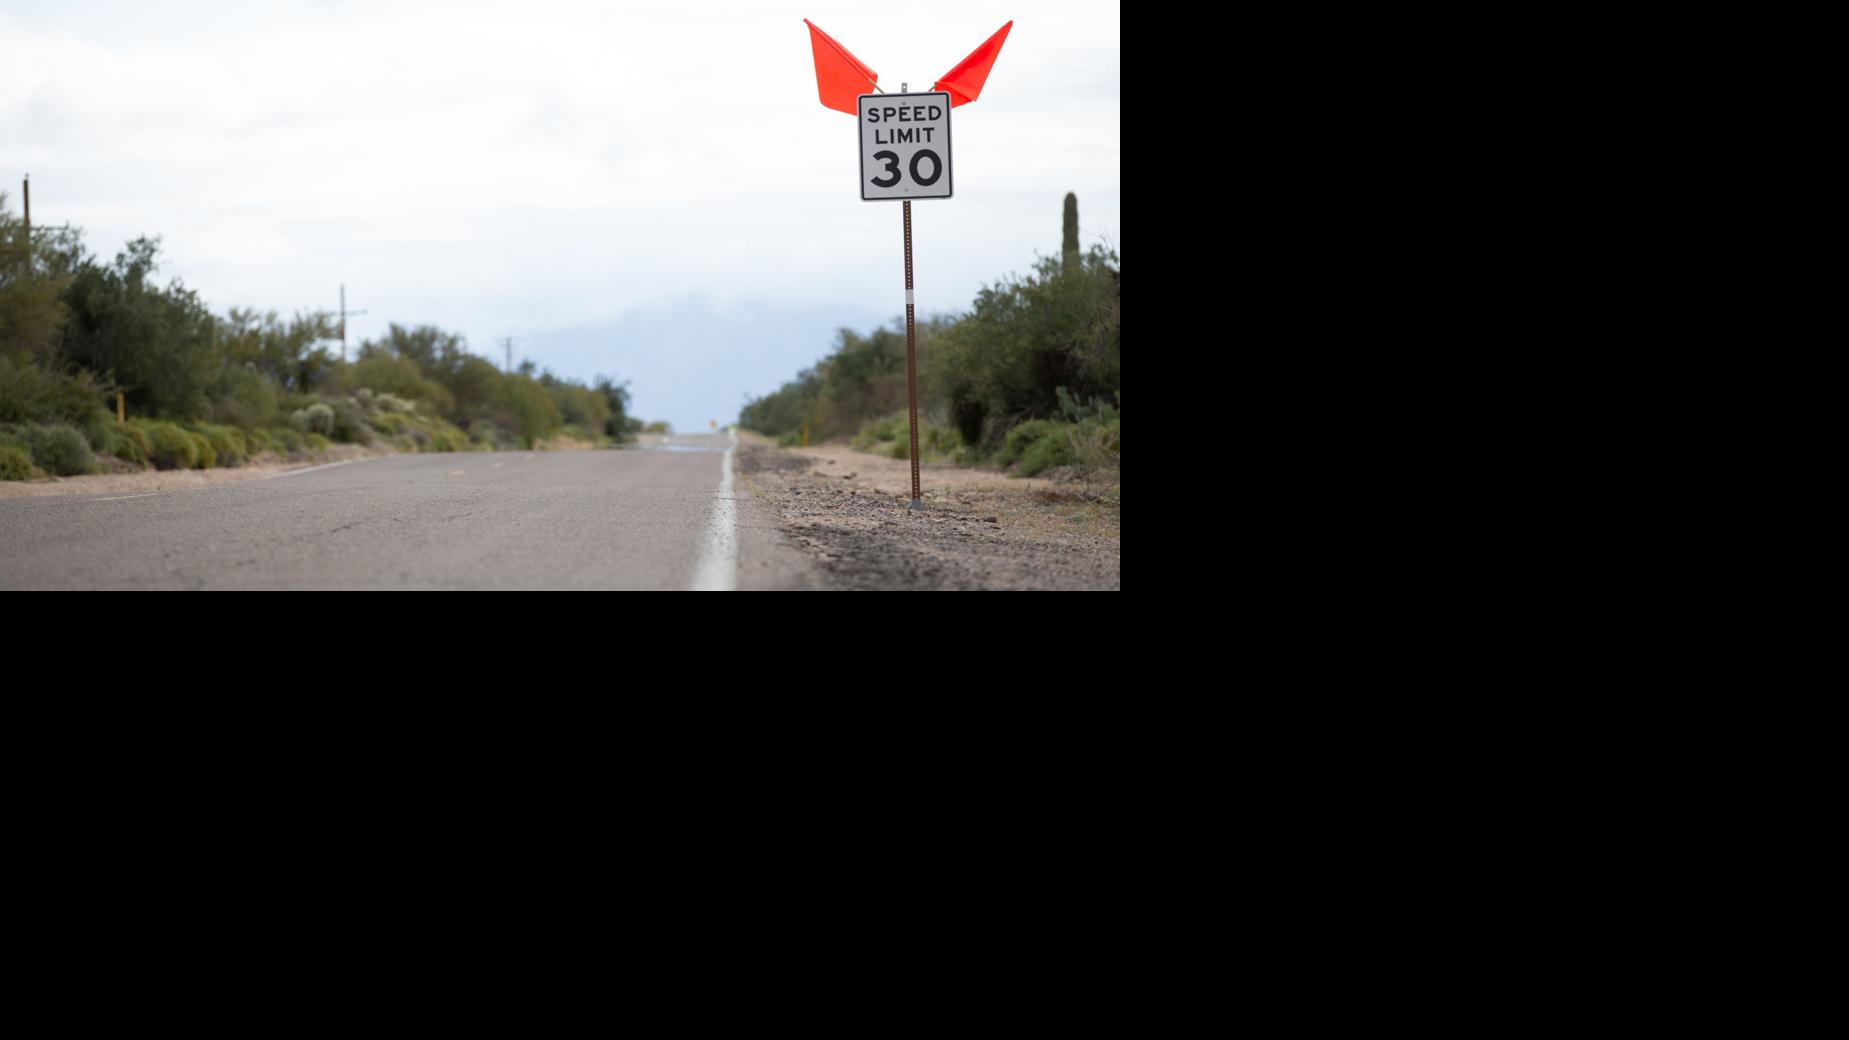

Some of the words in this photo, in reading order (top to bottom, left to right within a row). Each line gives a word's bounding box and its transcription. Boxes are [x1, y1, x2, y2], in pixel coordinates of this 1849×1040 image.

[867, 105, 942, 123] SPEED
[875, 127, 935, 144] LIMIT
[870, 149, 943, 188] 30
